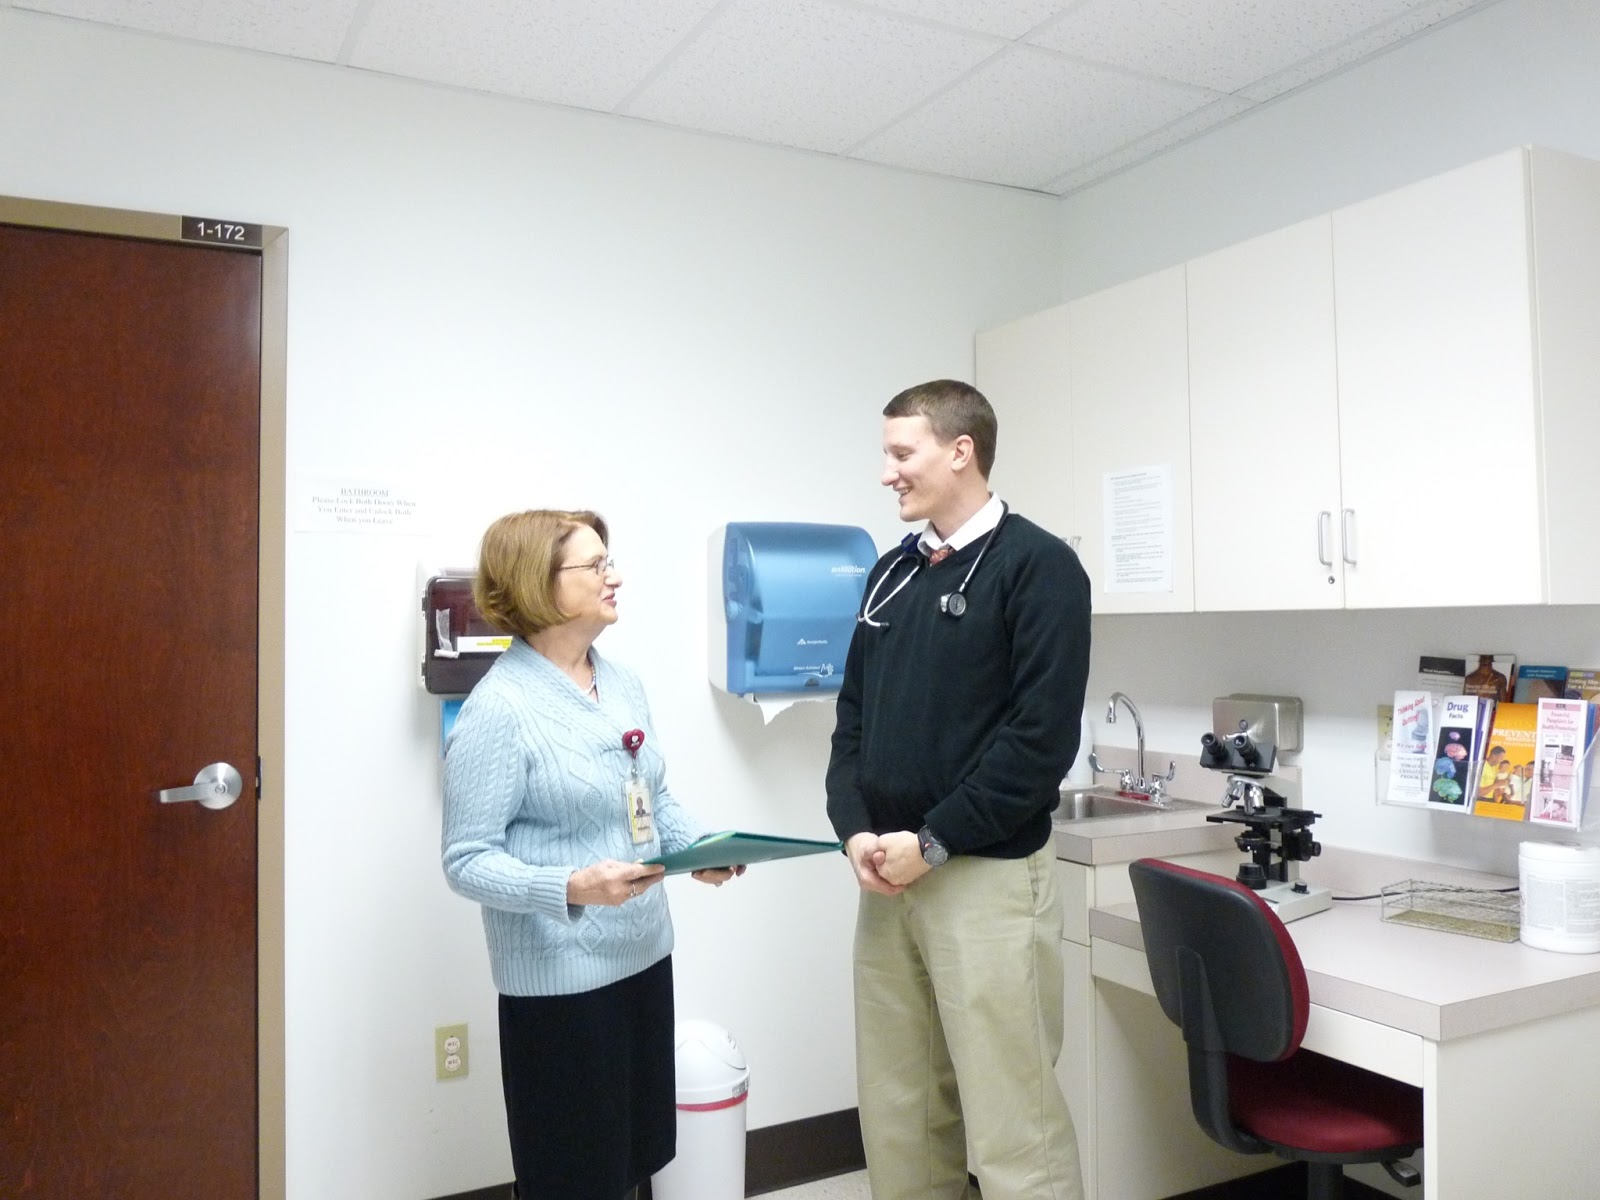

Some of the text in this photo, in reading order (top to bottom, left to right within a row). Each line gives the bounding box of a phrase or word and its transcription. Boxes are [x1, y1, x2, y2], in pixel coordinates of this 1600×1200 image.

[197, 221, 245, 241] 1-172
[340, 488, 389, 496] BATHROOM
[358, 517, 371, 525] you
[1447, 702, 1469, 713] Drug
